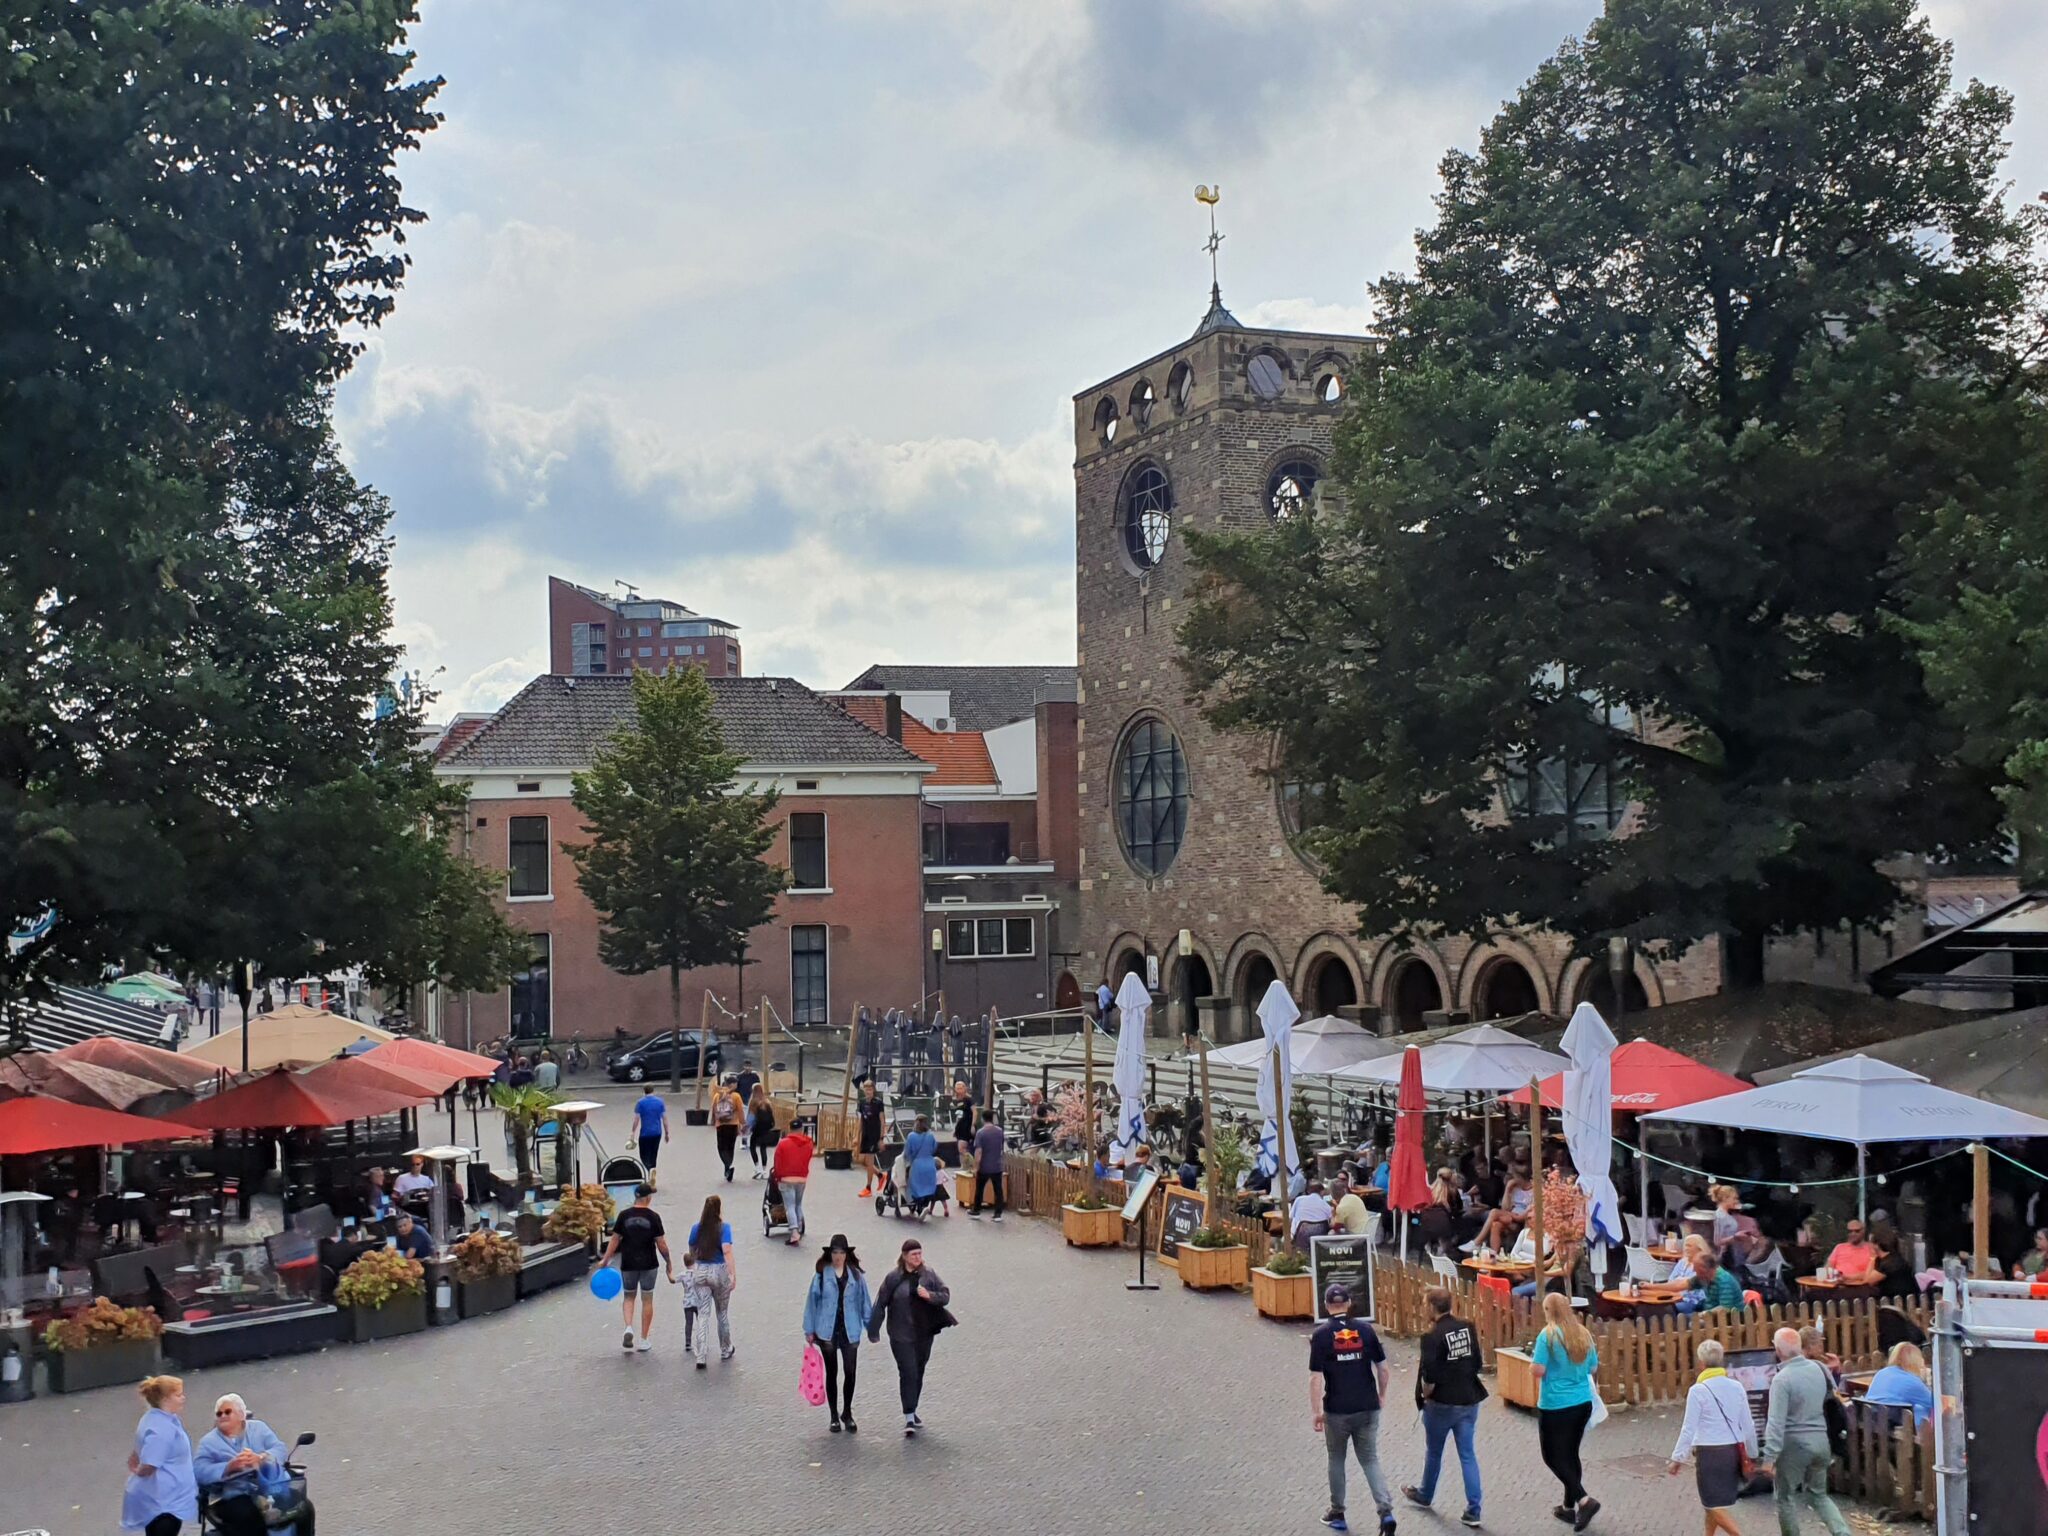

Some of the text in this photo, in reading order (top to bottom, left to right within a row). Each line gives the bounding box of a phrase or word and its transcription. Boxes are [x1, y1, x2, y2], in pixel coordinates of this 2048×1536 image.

[1751, 1098, 1820, 1113] PERONI
[1899, 1104, 1974, 1117] PERONI
[1175, 1216, 1191, 1231] NOVI
[1329, 1247, 1353, 1255] NOVI
